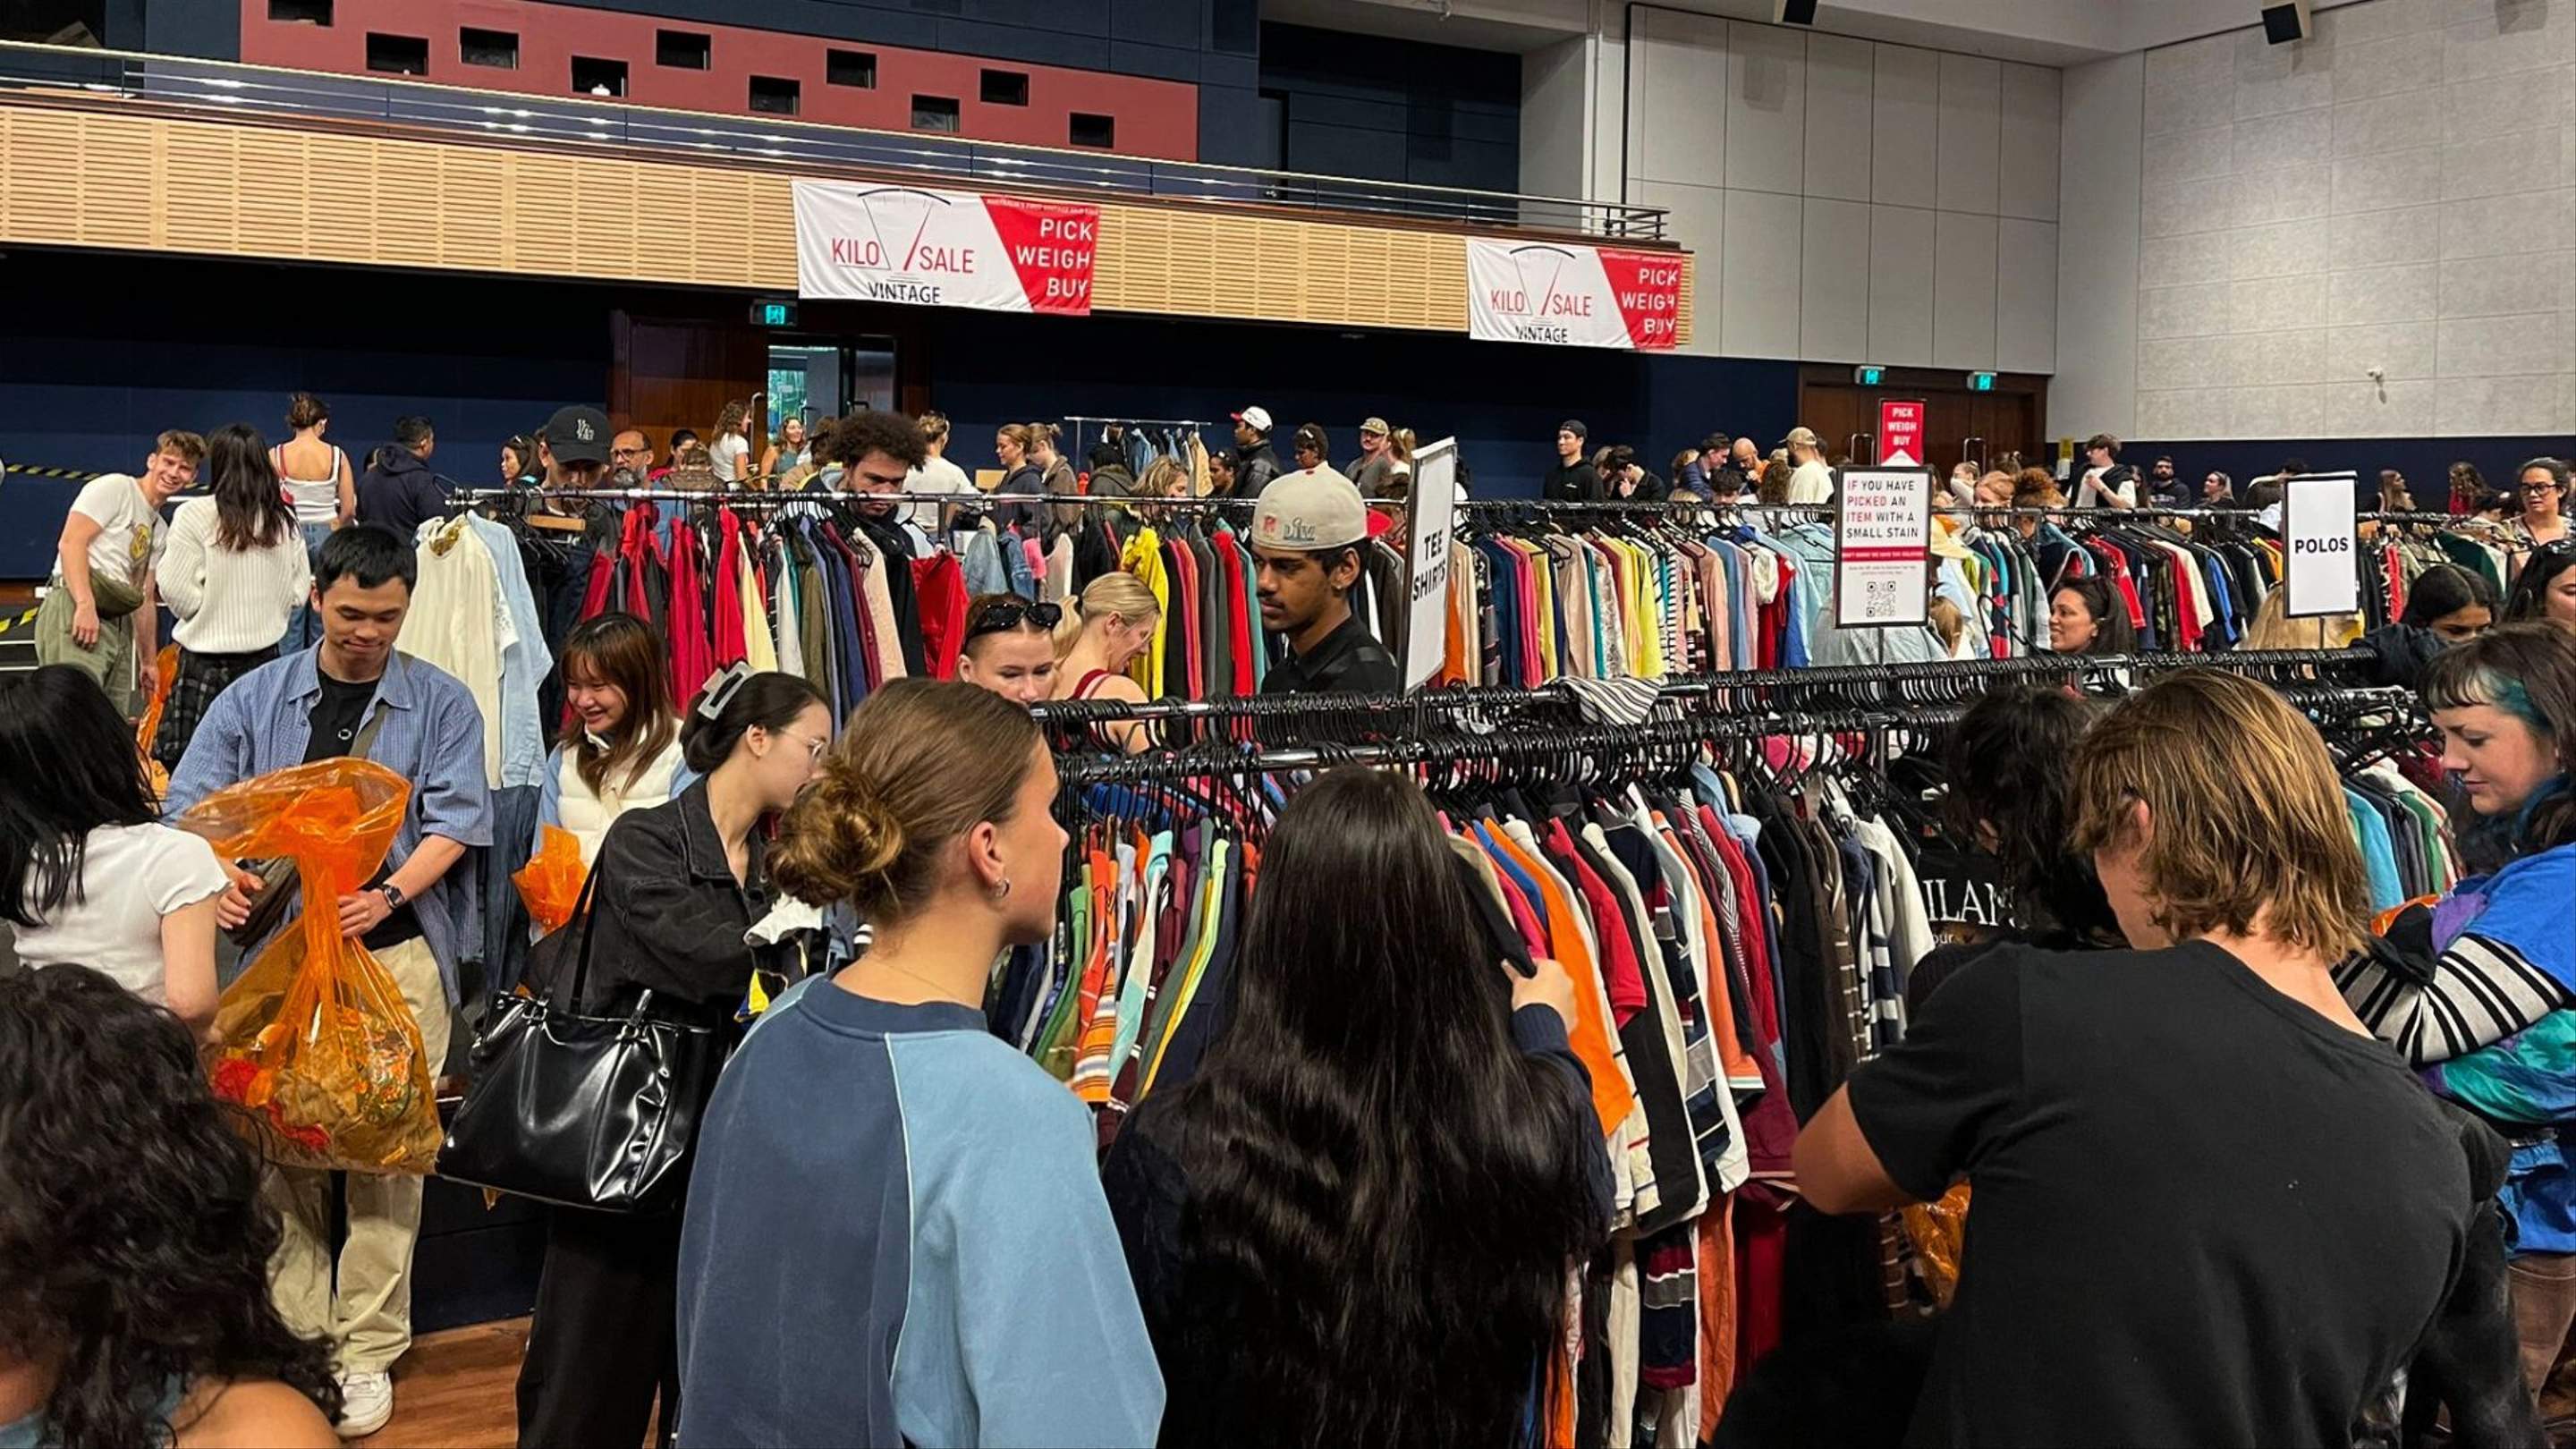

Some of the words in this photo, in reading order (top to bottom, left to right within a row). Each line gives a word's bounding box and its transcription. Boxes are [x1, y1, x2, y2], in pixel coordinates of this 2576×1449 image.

[1040, 218, 1092, 242] PICK
[832, 237, 879, 267] KILO
[919, 246, 974, 274] SALE
[1015, 245, 1090, 270] WEIGH
[1639, 267, 1678, 285] PICK
[869, 281, 940, 304] VINTAGE
[1046, 278, 1089, 299] BUY
[1491, 289, 1524, 313] KILO
[1553, 293, 1592, 317] SALE
[1622, 292, 1674, 310] WEIGH
[1515, 325, 1568, 343] VINTAGE
[1644, 318, 1675, 335] BUY
[1892, 407, 1914, 418] PICK
[1887, 421, 1917, 432] WEIGH
[1893, 435, 1911, 445] BUY
[1847, 480, 1858, 492] IF
[1861, 480, 1883, 491] YOU
[1886, 480, 1915, 491] HAVE
[1847, 496, 1887, 507] PICKED
[1891, 496, 1906, 506] AN
[1847, 512, 1872, 522] ITEM
[1876, 512, 1903, 522] WITH
[1907, 512, 1914, 521] A
[1846, 528, 1883, 538] SMALL
[1886, 528, 1919, 538] STAIN
[1423, 529, 1443, 561] TEE
[2294, 537, 2349, 554] POLOS
[1412, 558, 1446, 601] SHIRTS
